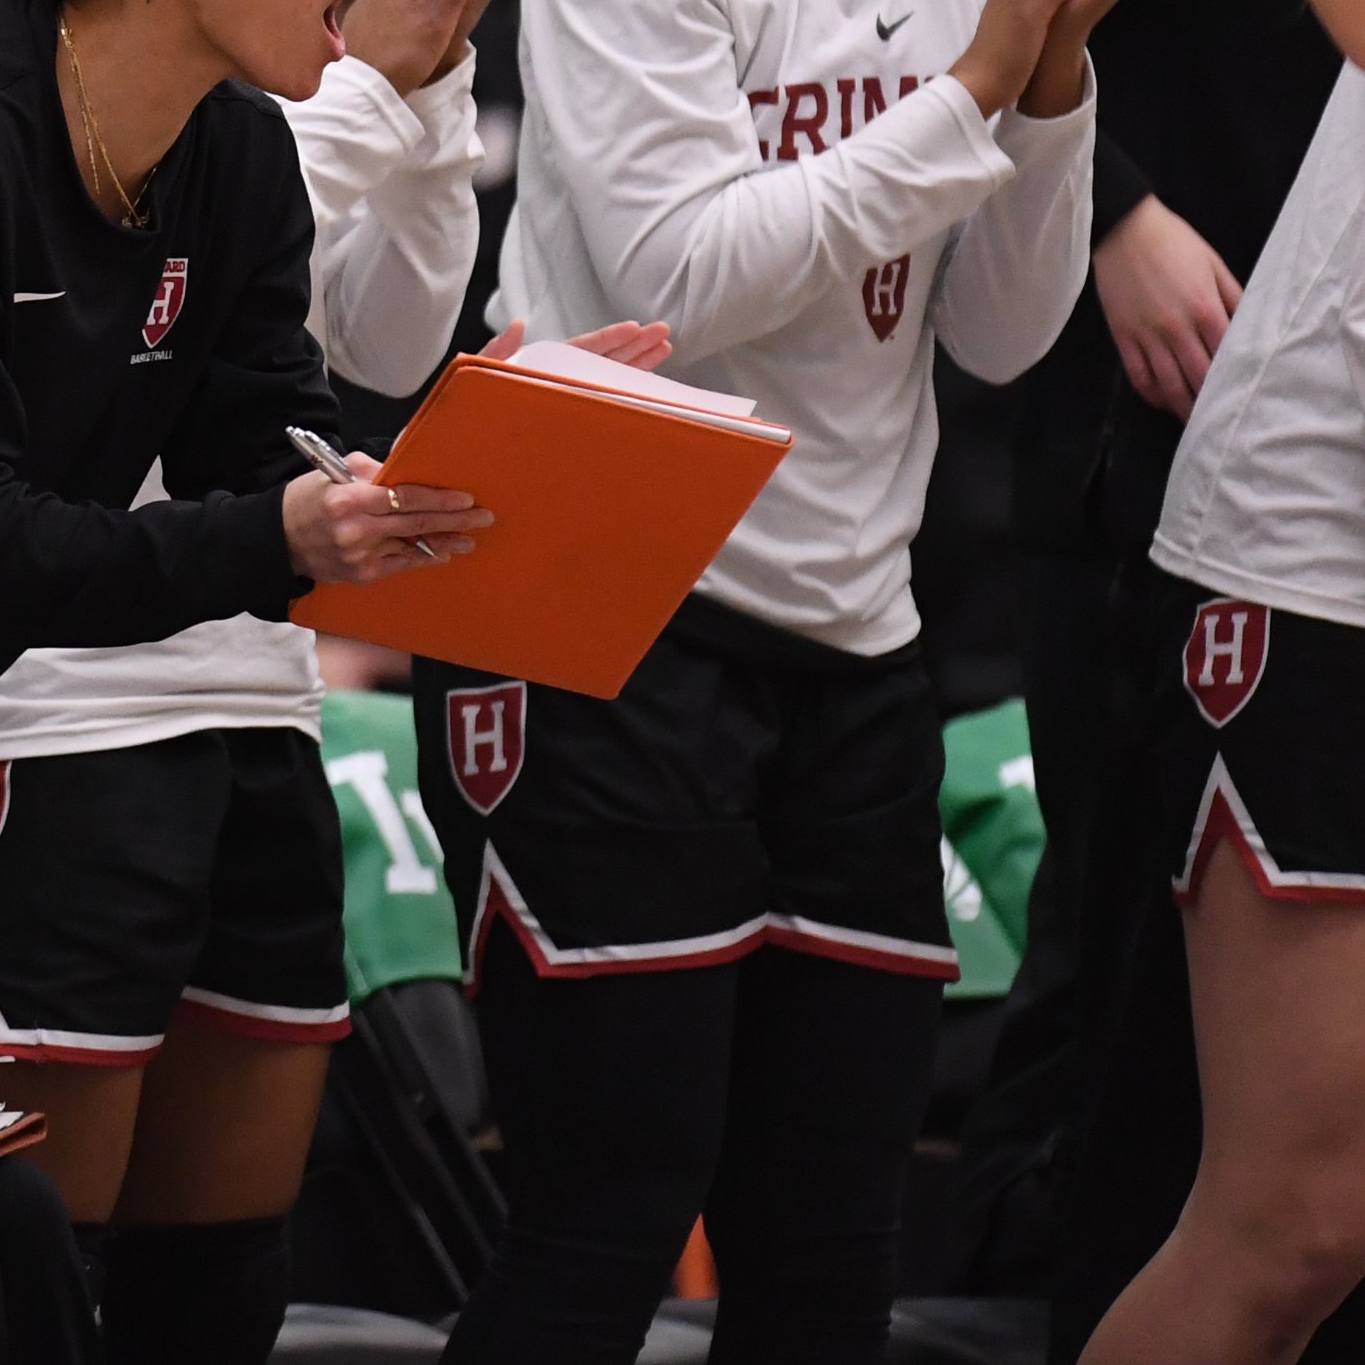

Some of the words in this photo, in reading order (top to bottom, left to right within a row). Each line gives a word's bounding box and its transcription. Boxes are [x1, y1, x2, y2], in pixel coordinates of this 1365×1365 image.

[146, 281, 175, 325] H
[871, 260, 901, 315] H
[1198, 611, 1248, 686] H
[462, 700, 507, 776] H
